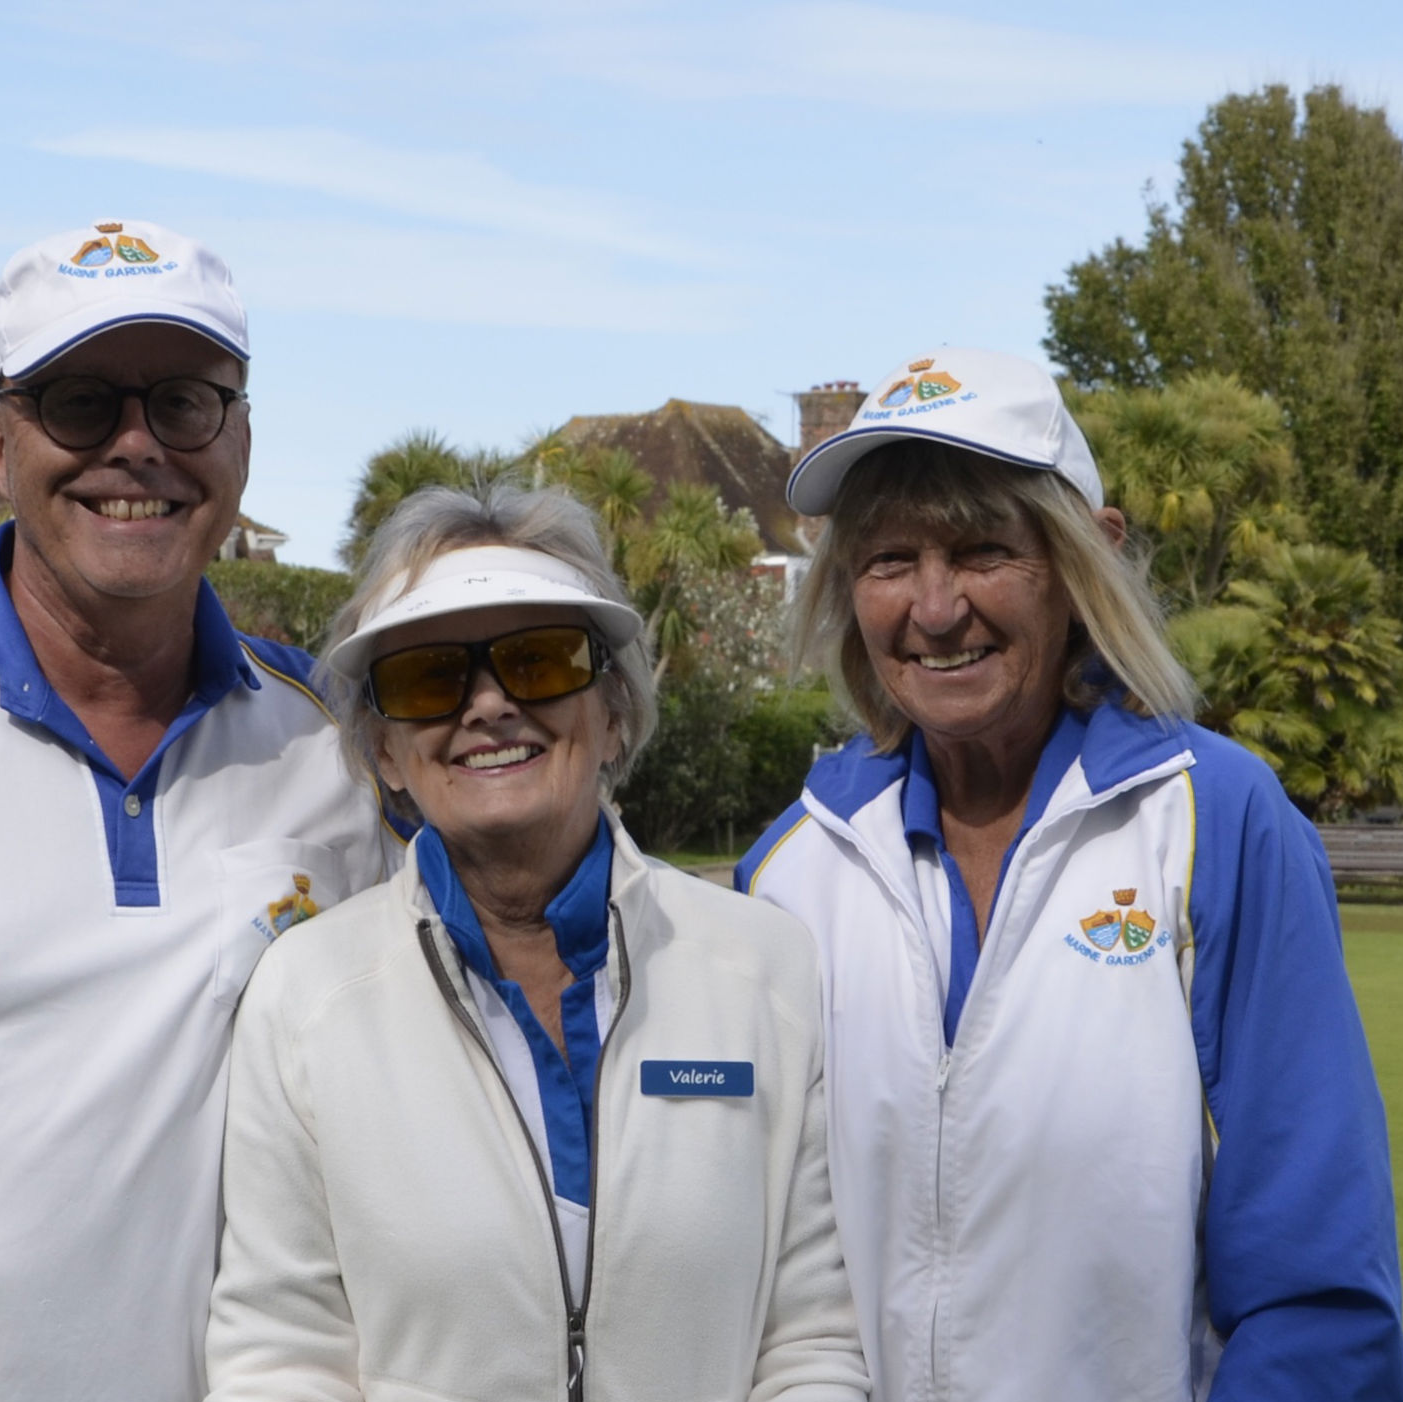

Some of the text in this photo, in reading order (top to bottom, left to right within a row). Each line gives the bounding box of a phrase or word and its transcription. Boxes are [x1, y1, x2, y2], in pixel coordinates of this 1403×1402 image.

[57, 263, 98, 278] MARINE
[897, 397, 956, 417] GARDENS
[1063, 933, 1101, 962] MARINE
[1106, 945, 1156, 965] GARDENS
[669, 1069, 725, 1085] Valerie
